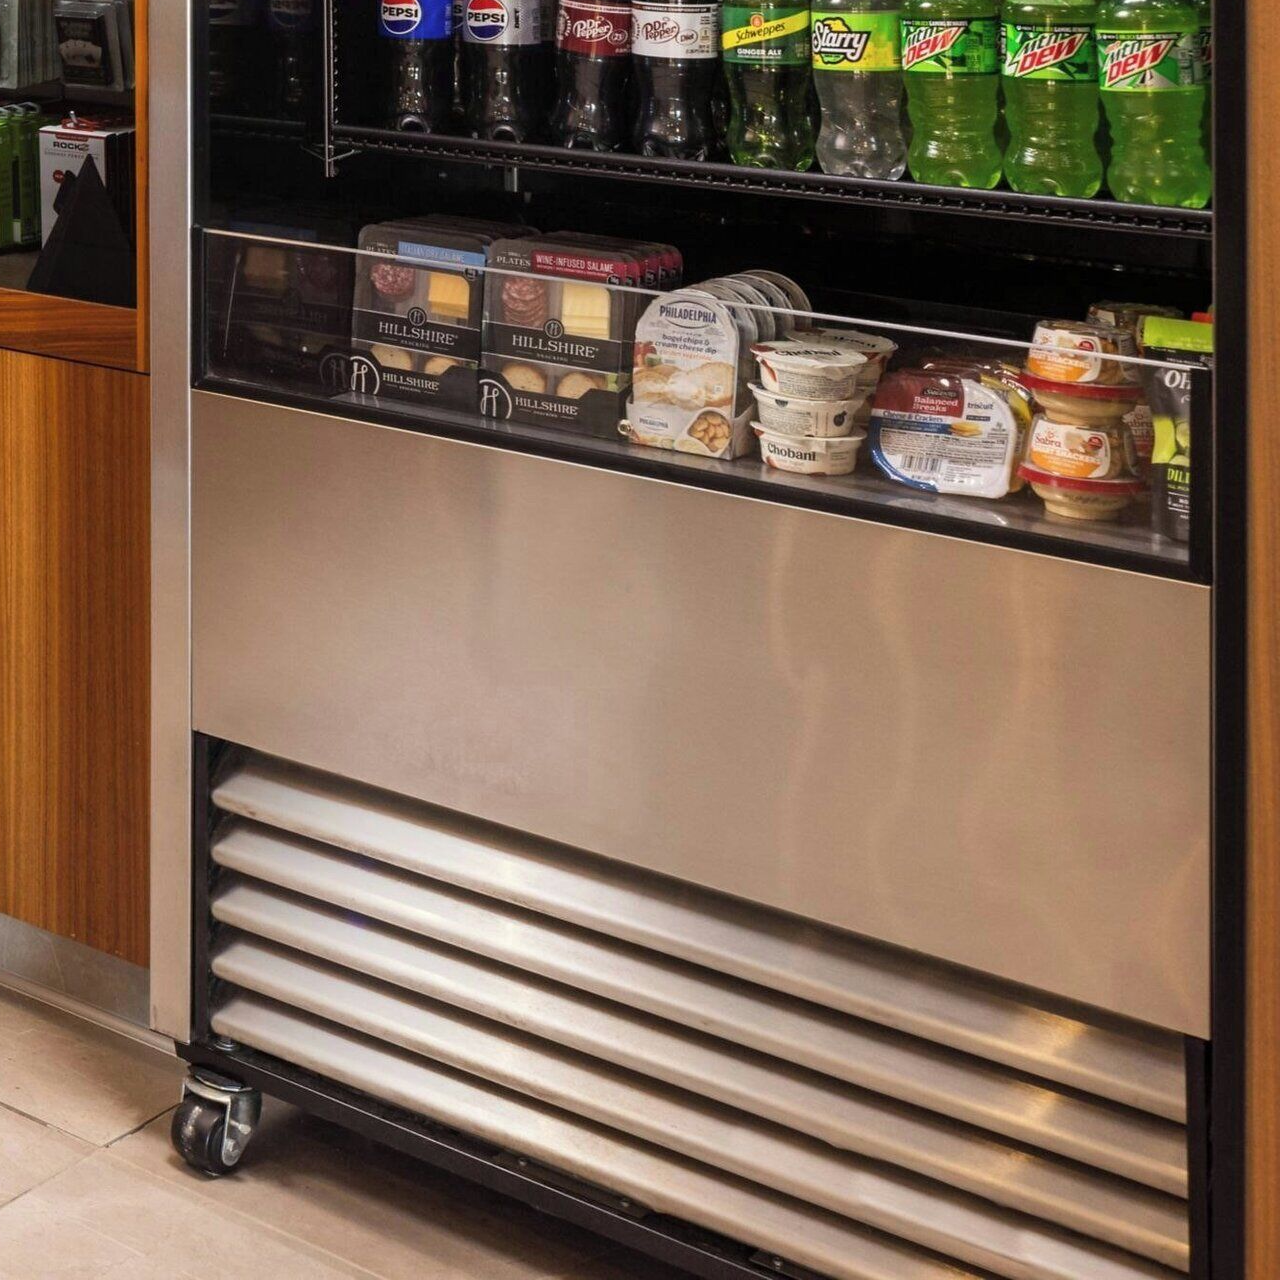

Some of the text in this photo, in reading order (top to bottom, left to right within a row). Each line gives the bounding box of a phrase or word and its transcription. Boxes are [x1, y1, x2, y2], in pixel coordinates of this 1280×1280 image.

[382, 6, 419, 19] PEPSI
[467, 11, 505, 25] PEPSI
[513, 7, 521, 30] DIET
[573, 22, 610, 42] Pepper
[585, 18, 598, 30] Dr
[642, 24, 677, 42] Pepper
[654, 19, 668, 31] Dr
[735, 21, 786, 44] Schweppes
[812, 19, 868, 61] Starry
[737, 47, 782, 57] GINGER ALE
[496, 255, 532, 268] PLATES
[535, 253, 614, 275] WINE-INFUSED SALAME
[659, 303, 718, 326] PHILADELPHIA
[379, 320, 454, 348] HILLSHIRE
[662, 333, 702, 348] bagel chips
[512, 333, 595, 360] HILLSHIRE
[654, 341, 718, 357] cream cheese dip
[383, 372, 440, 391] HILLSHIRE
[515, 395, 579, 416] HILLSHIRE
[913, 394, 959, 409] Balanced
[913, 402, 947, 413] Breaks
[967, 400, 994, 411] triscuit
[766, 441, 817, 463] Chobani
